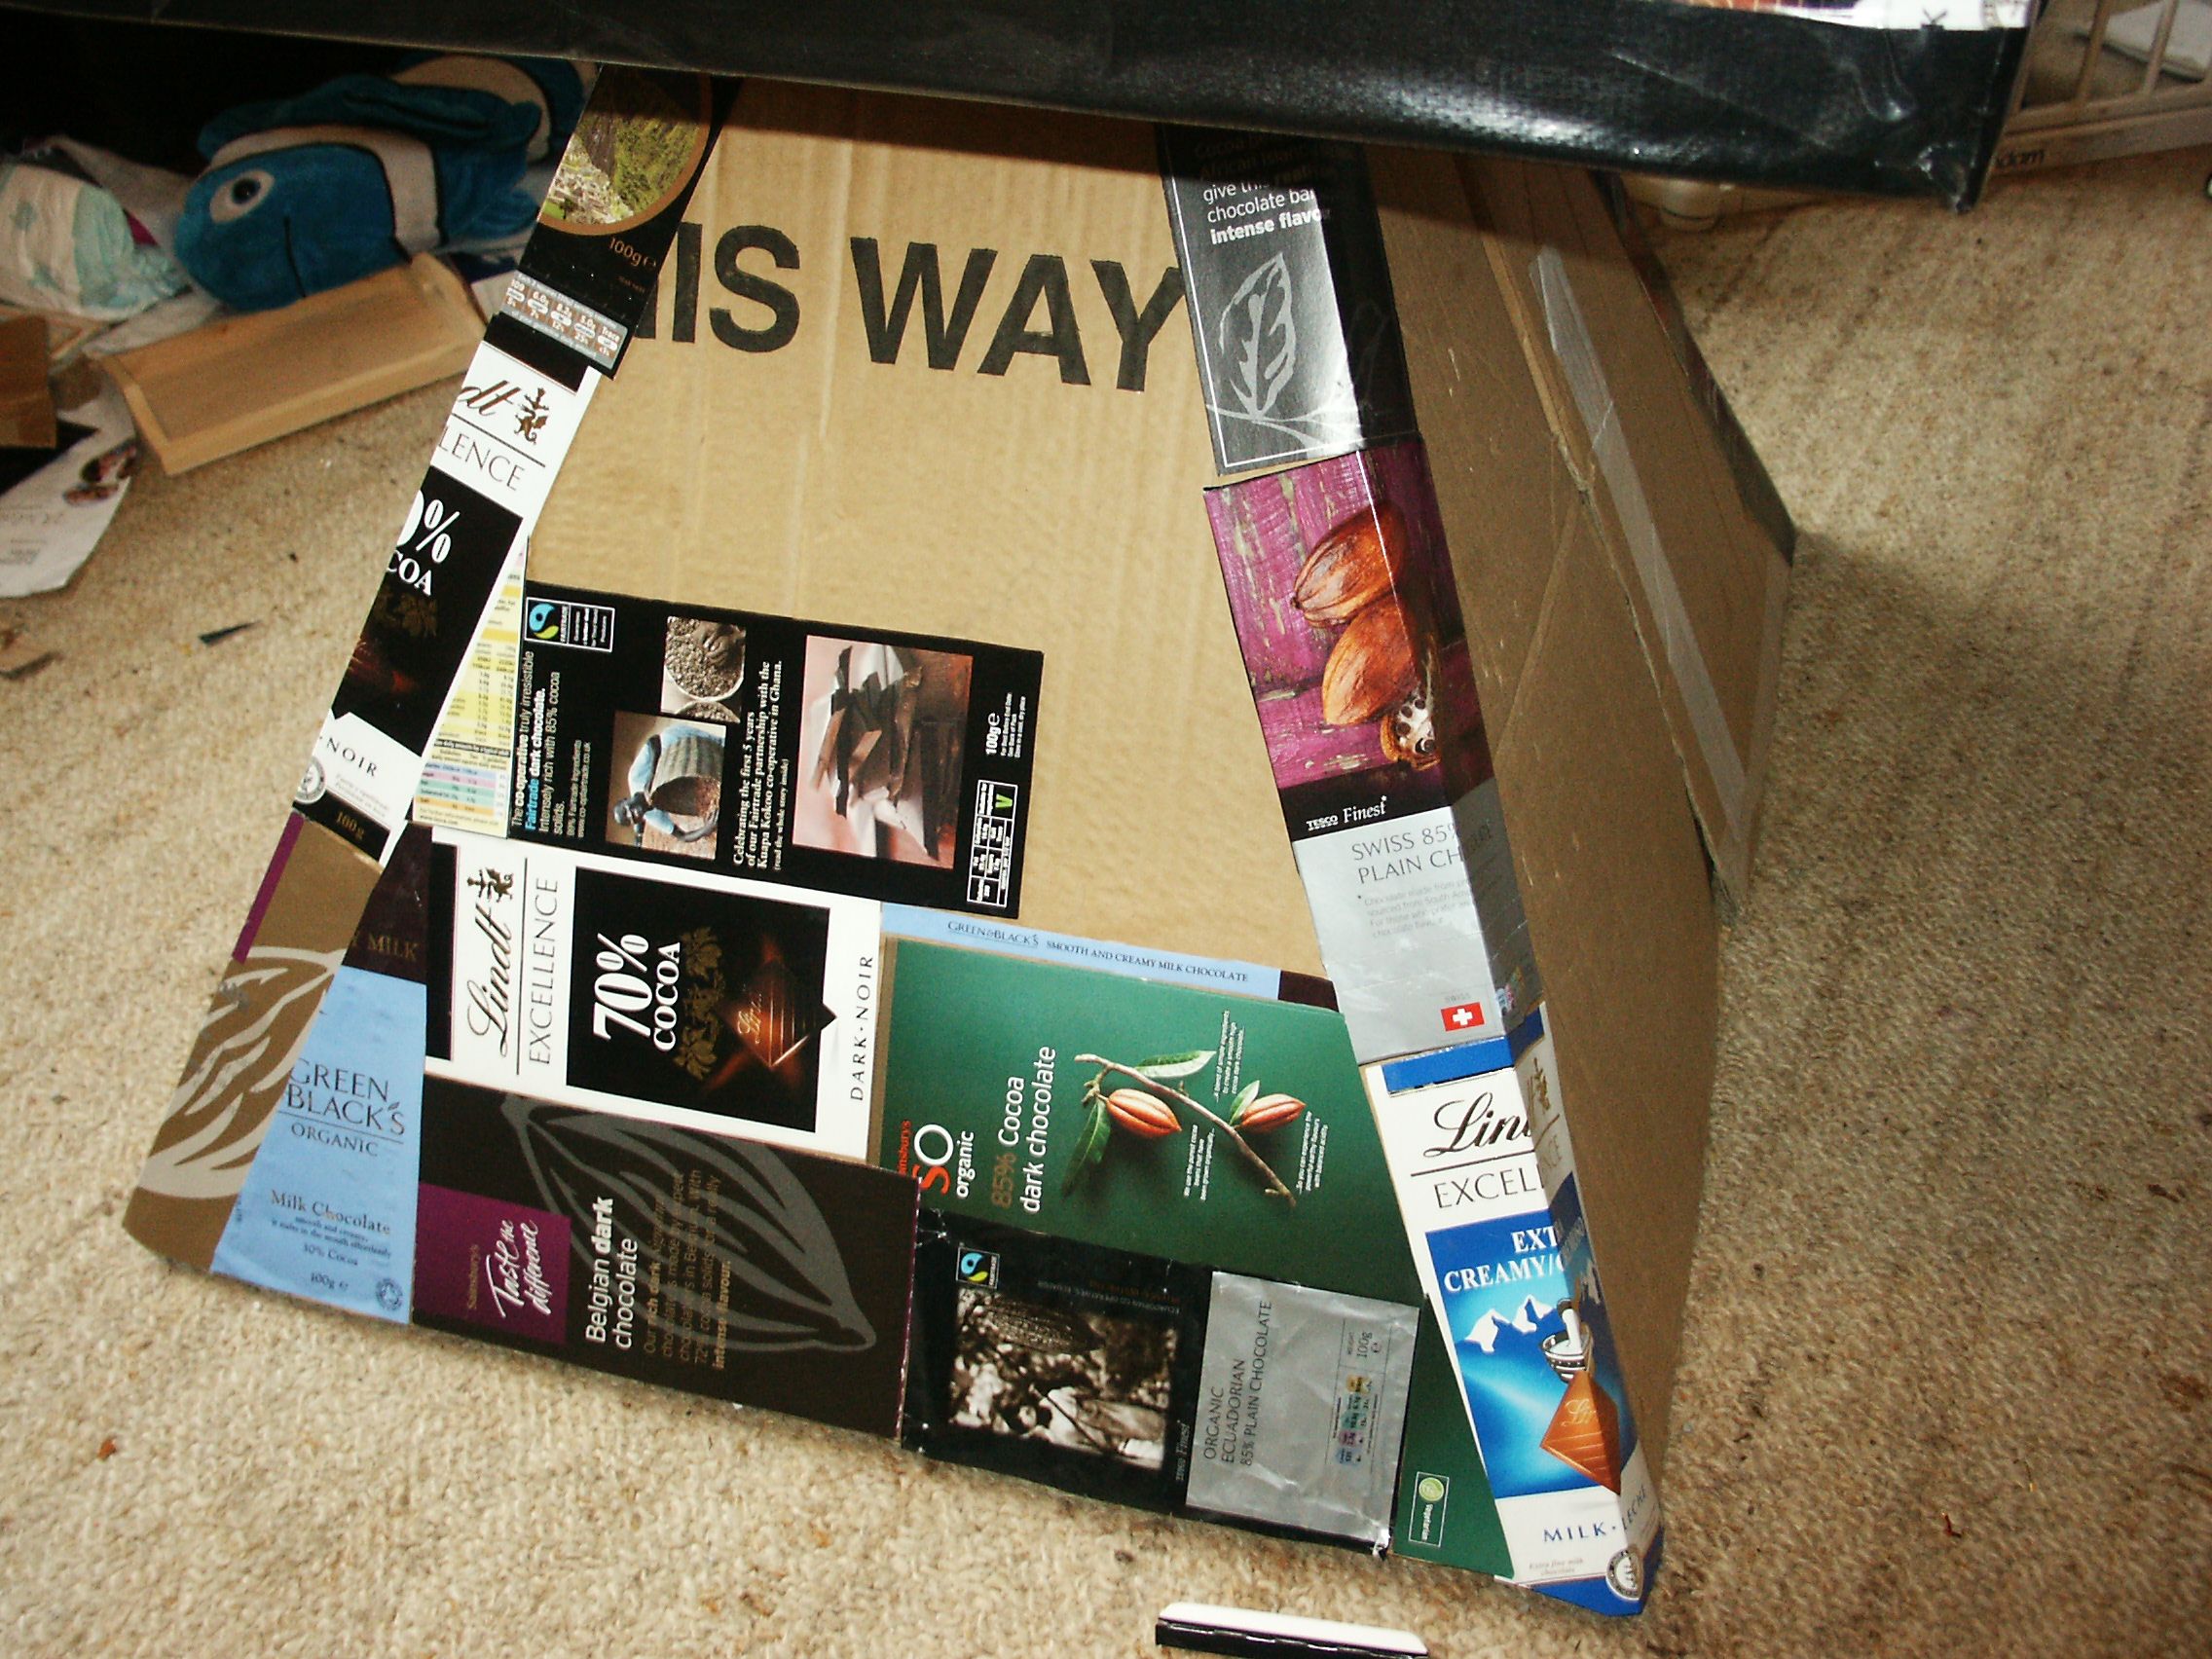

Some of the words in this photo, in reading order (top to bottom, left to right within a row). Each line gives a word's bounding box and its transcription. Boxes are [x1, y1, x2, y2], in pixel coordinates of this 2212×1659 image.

[1203, 184, 1236, 204] give
[1207, 196, 1284, 223] chocolate
[1210, 220, 1275, 245] intense
[609, 235, 642, 268] 100g
[850, 237, 1186, 391] WAY
[601, 325, 620, 342] Trace
[438, 425, 525, 491] LENCE
[520, 651, 535, 707] irresistible
[759, 661, 770, 681] the
[769, 660, 783, 702] Ghana.
[548, 672, 561, 705] cocoa
[757, 683, 770, 708] with
[519, 709, 533, 733] truly
[531, 688, 546, 748] chocolate.
[545, 708, 558, 733] 85%
[744, 712, 756, 741] years
[768, 705, 780, 717] in
[326, 737, 378, 776] NOIR
[543, 737, 556, 758] with
[754, 711, 769, 776] partnership
[763, 719, 779, 788] co-operative
[985, 726, 1002, 756] 100g
[514, 734, 529, 807] co-operative
[529, 750, 542, 778] dark
[541, 761, 554, 783] rich
[740, 755, 753, 777] first
[526, 779, 539, 830] Fairtrade
[738, 780, 751, 797] the
[749, 779, 762, 830] Fairtrade
[778, 788, 789, 807] story
[512, 808, 525, 827] The
[538, 785, 553, 832] Intensely
[553, 801, 565, 835] solids.
[760, 791, 773, 829] Kokoo
[776, 809, 785, 833] whole
[1307, 816, 1339, 830] TESCO
[733, 800, 750, 865] Celebrating
[748, 831, 758, 852] our
[756, 831, 771, 868] Kuapa
[774, 834, 783, 848] the
[1351, 832, 1415, 860] SWISS
[746, 853, 756, 866] of
[1358, 855, 1422, 884] PLAIN
[1403, 897, 1424, 910] from
[1424, 892, 1450, 906] South
[368, 933, 421, 962] MILK
[1046, 940, 1088, 956] SMOOTH
[1090, 948, 1113, 961] AND
[1114, 952, 1157, 970] CREAMY
[1159, 959, 1183, 973] MILK
[1185, 963, 1248, 983] CHOCOLATE
[466, 903, 512, 1058] Lindt
[529, 877, 558, 1065] EXCELLENCE
[593, 933, 653, 1041] 70%
[653, 942, 681, 1051] COCOA
[290, 1057, 389, 1102] GREEN
[997, 1076, 1024, 1146] Cocoa
[1025, 1047, 1056, 1157] chocolate
[291, 1123, 379, 1157] ORGANIC
[911, 1124, 954, 1197] SO
[955, 1130, 976, 1198] organic
[991, 1153, 1017, 1208] 85%
[1019, 1161, 1045, 1214] dark
[272, 1190, 307, 1212] Milk
[312, 1200, 391, 1235] Chocolate
[590, 1197, 613, 1254] dark
[499, 1220, 515, 1242] the
[328, 1249, 358, 1267] Cocoa
[520, 1219, 552, 1315] difference
[311, 1272, 335, 1290] 100g
[486, 1240, 525, 1318] Taste
[612, 1237, 639, 1349] chocolate
[647, 1262, 661, 1296] dark
[716, 1261, 731, 1312] flavour.
[585, 1259, 613, 1343] Belgian
[646, 1297, 659, 1326] rich
[644, 1327, 657, 1353] Our
[712, 1318, 728, 1369] intense
[1249, 1300, 1272, 1392] CHOCOLATE
[1356, 1332, 1373, 1358] 100g
[1203, 1386, 1225, 1460] ORGANIC
[1221, 1358, 1245, 1464] ECUADORIAN
[1243, 1395, 1261, 1437] PLAIN
[1239, 1442, 1255, 1466] 85%
[1543, 1521, 1606, 1542] MILK
